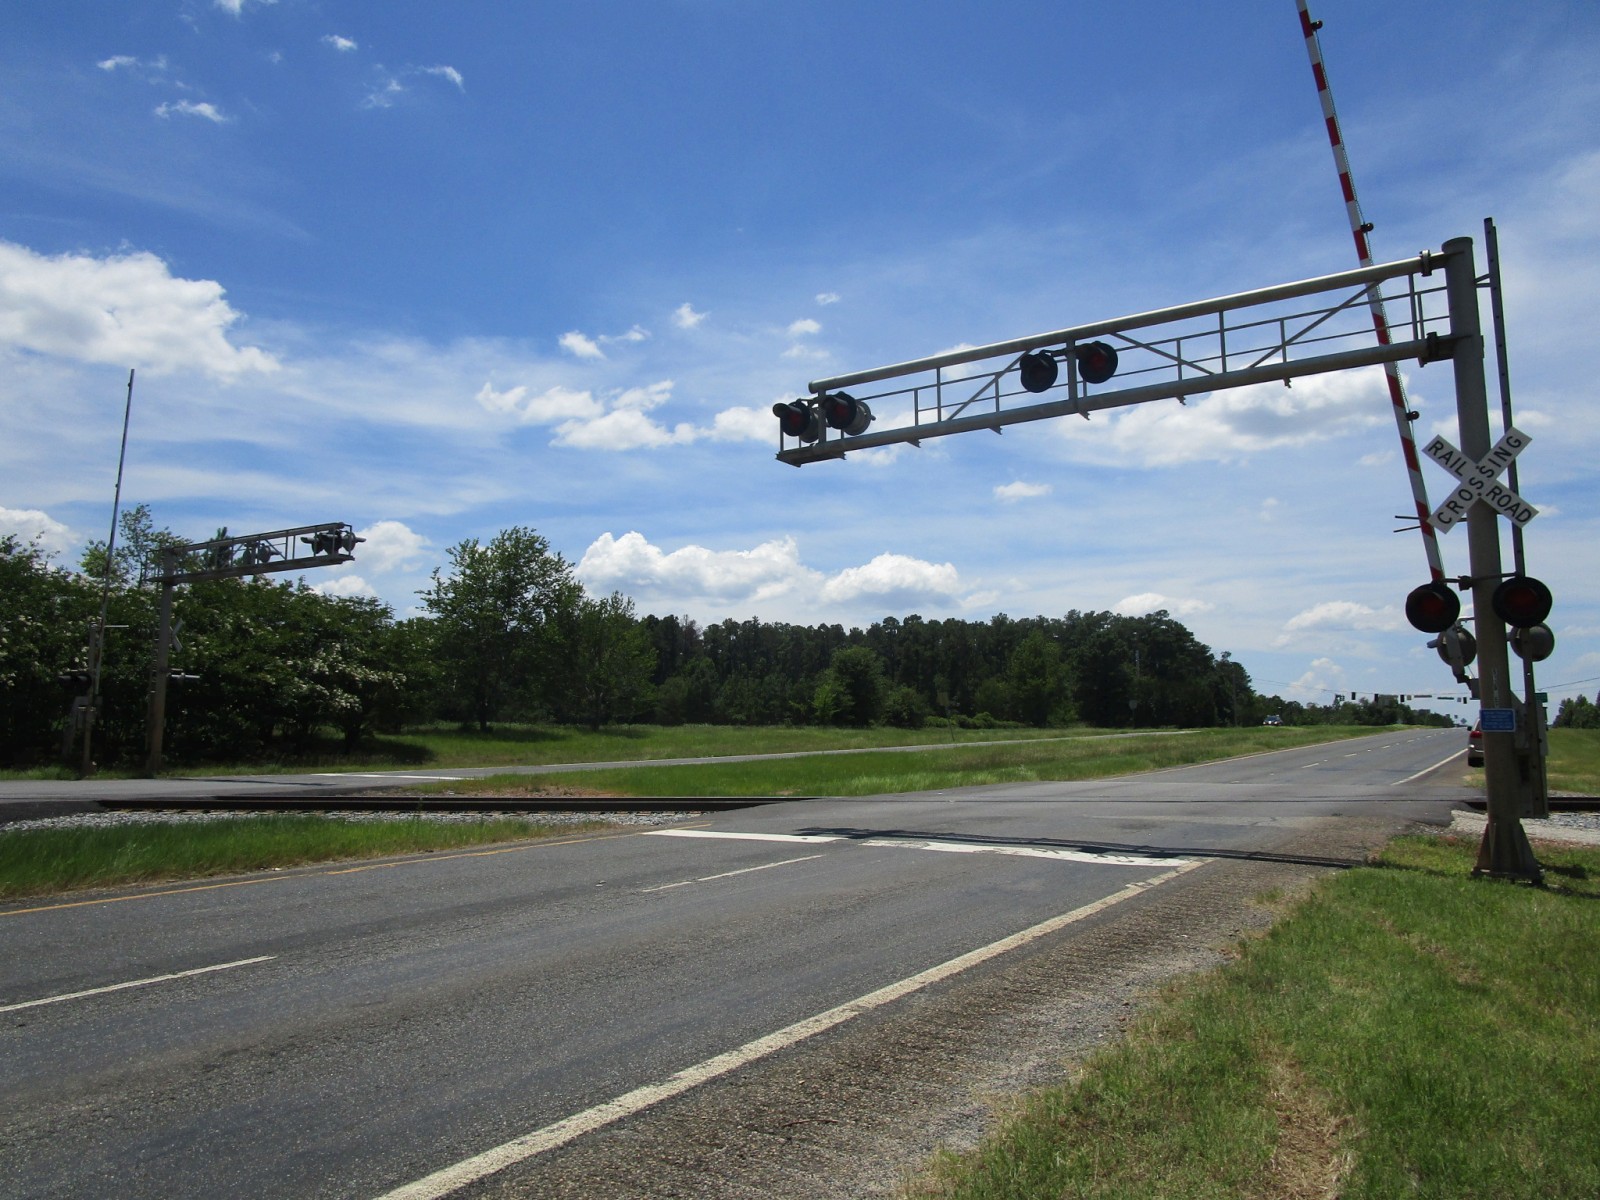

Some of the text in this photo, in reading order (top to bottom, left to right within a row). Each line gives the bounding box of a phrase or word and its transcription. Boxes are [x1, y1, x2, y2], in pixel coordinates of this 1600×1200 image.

[1428, 440, 1532, 523] RAIL ROAD
[1437, 435, 1522, 524] CROSSING
